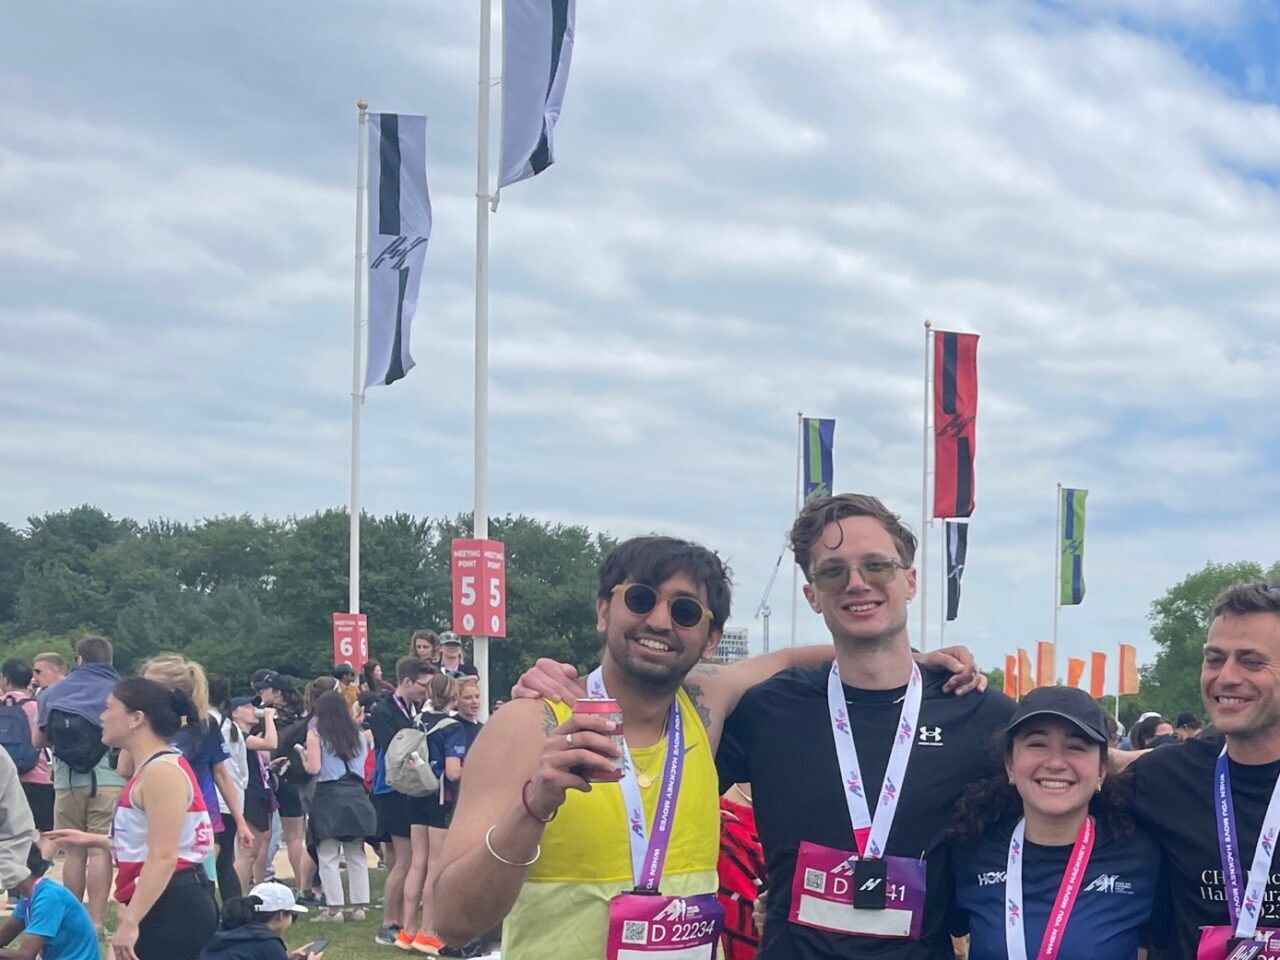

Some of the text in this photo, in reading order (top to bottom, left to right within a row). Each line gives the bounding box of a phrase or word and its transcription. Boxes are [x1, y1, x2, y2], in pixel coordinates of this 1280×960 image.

[458, 560, 476, 568] POINT
[461, 576, 476, 606] 5
[489, 577, 501, 608] 5
[340, 637, 353, 656] 6
[667, 757, 680, 799] HACKNEY
[658, 801, 672, 832] MOVES
[1223, 818, 1232, 843] MOVE
[651, 849, 660, 877] WHEN
[1225, 845, 1238, 886] HACKNEY
[834, 878, 848, 895] D
[977, 871, 1006, 886] HOK
[1201, 870, 1226, 885] CH
[1046, 930, 1058, 956] WHEN
[1055, 910, 1065, 929] YOU
[1061, 884, 1074, 909] MOVE
[1070, 844, 1087, 885] HACKNEY
[1200, 887, 1229, 901] Hal
[1232, 887, 1241, 919] MOVE
[651, 919, 716, 942] D 22234
